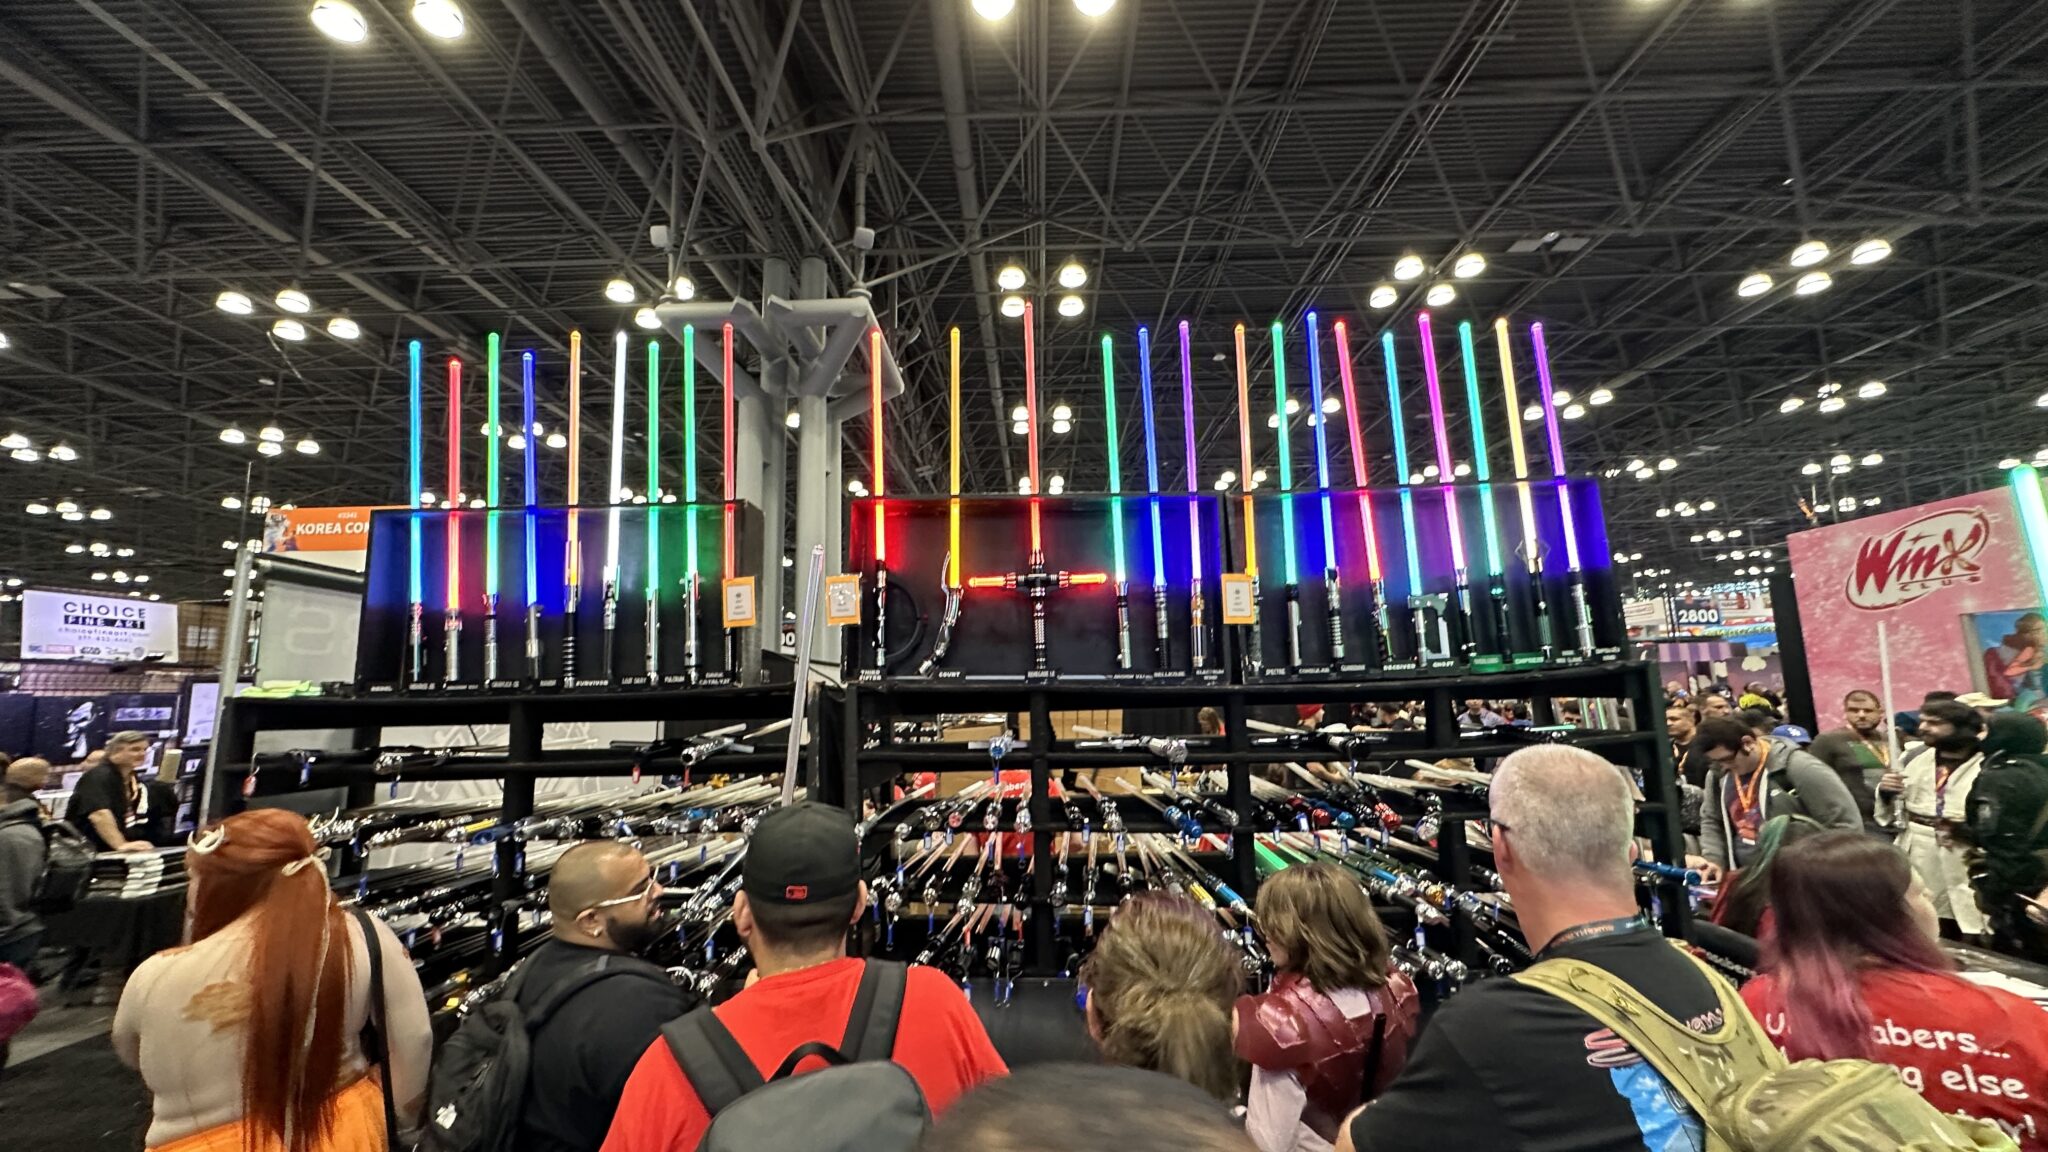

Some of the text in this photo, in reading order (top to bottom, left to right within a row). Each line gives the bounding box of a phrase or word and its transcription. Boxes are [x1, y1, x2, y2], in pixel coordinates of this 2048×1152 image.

[296, 522, 341, 535] KOREA
[1856, 523, 1981, 596] Winx
[63, 601, 146, 618] CHOICE
[1679, 609, 1718, 623] 2800
[68, 615, 143, 629] FINE ART
[1383, 663, 1416, 671] DECEIVED
[1941, 1064, 2030, 1100] else
